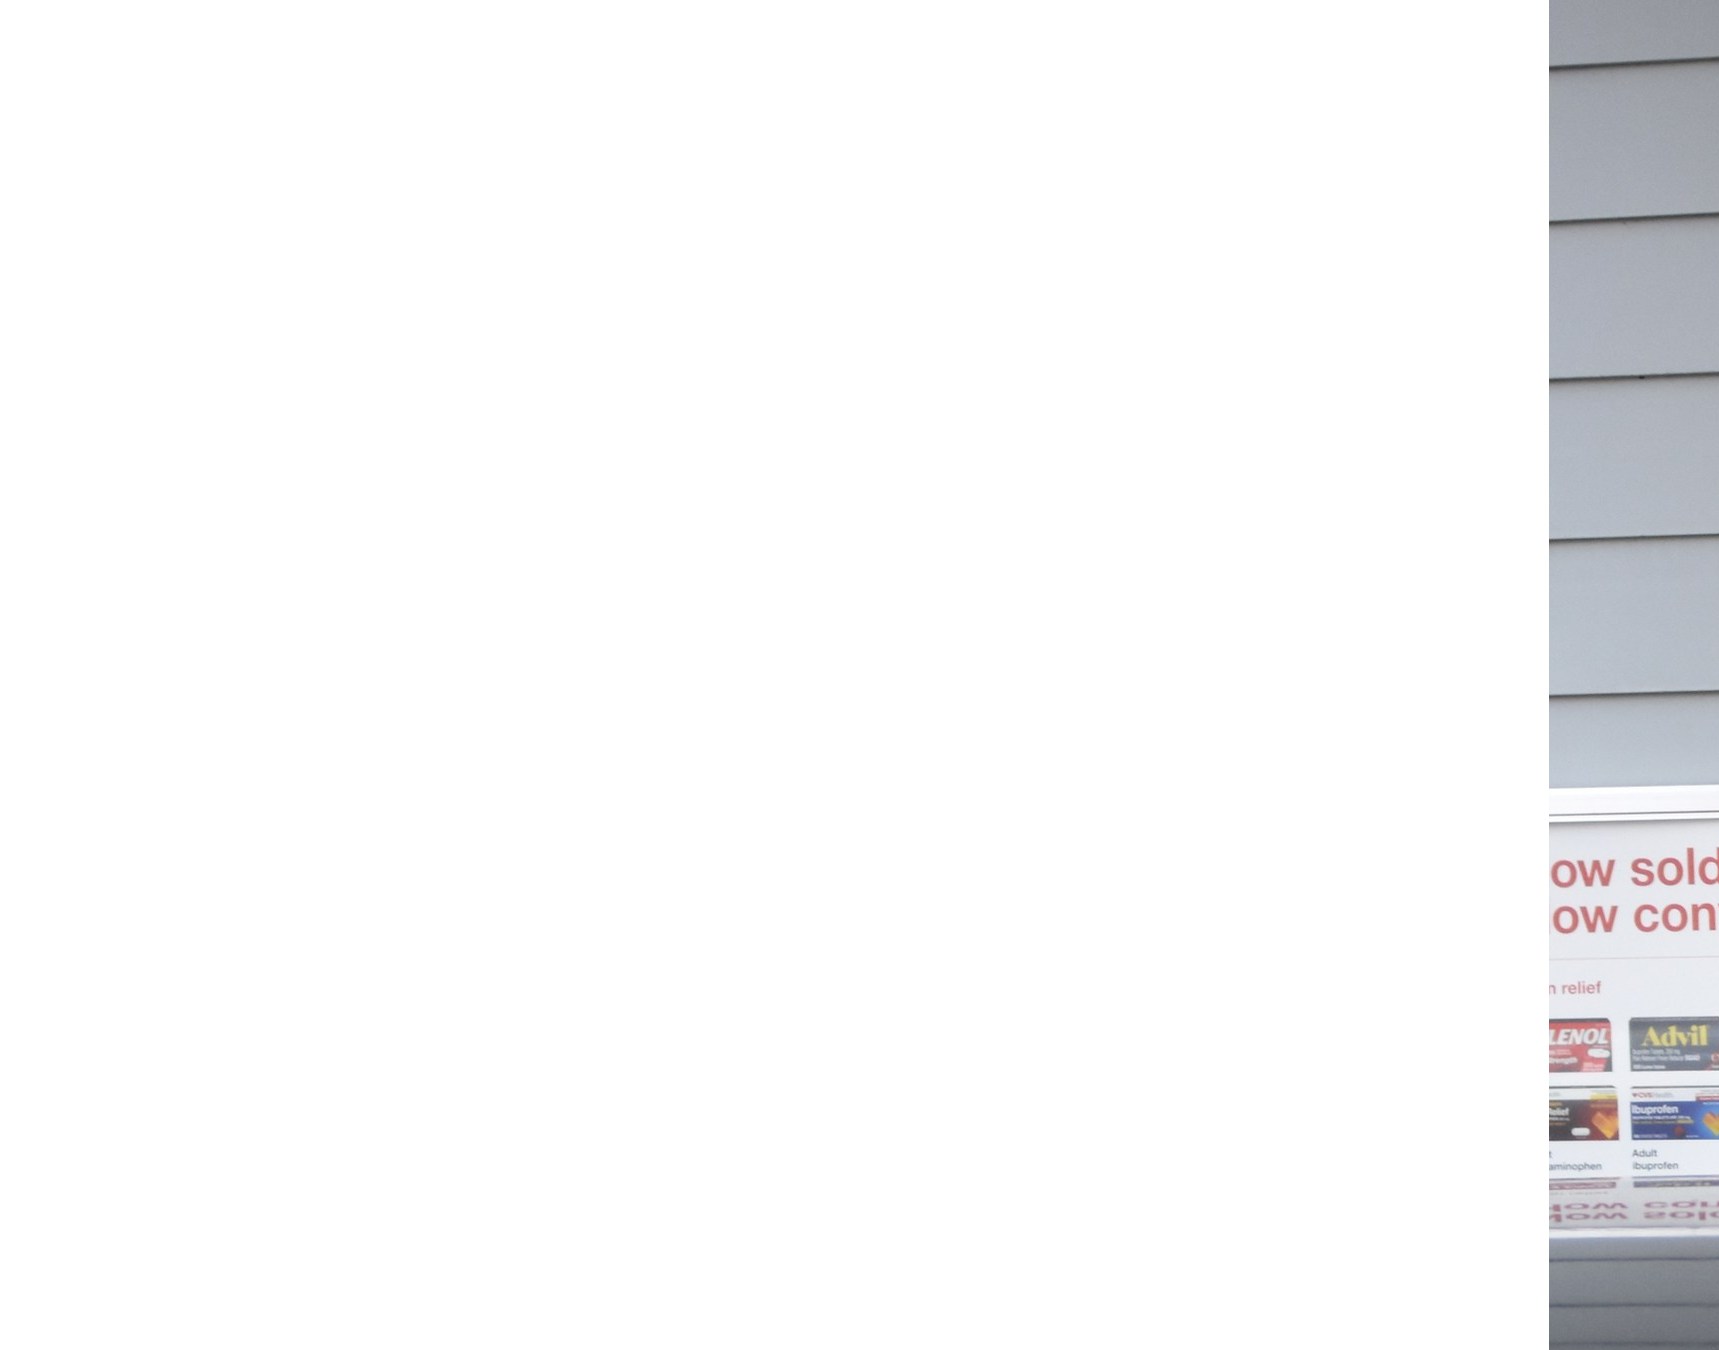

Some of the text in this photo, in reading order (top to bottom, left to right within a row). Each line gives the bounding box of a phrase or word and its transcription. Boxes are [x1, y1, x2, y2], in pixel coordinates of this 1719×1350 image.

[1551, 859, 1615, 888] ow
[1553, 905, 1618, 934] ow
[1561, 980, 1602, 995] relief
[1640, 1024, 1710, 1048] Advil
[1632, 1104, 1679, 1115] Ibuprofen
[1632, 1149, 1658, 1158] Adult
[1632, 1161, 1679, 1172] ibuprofen
